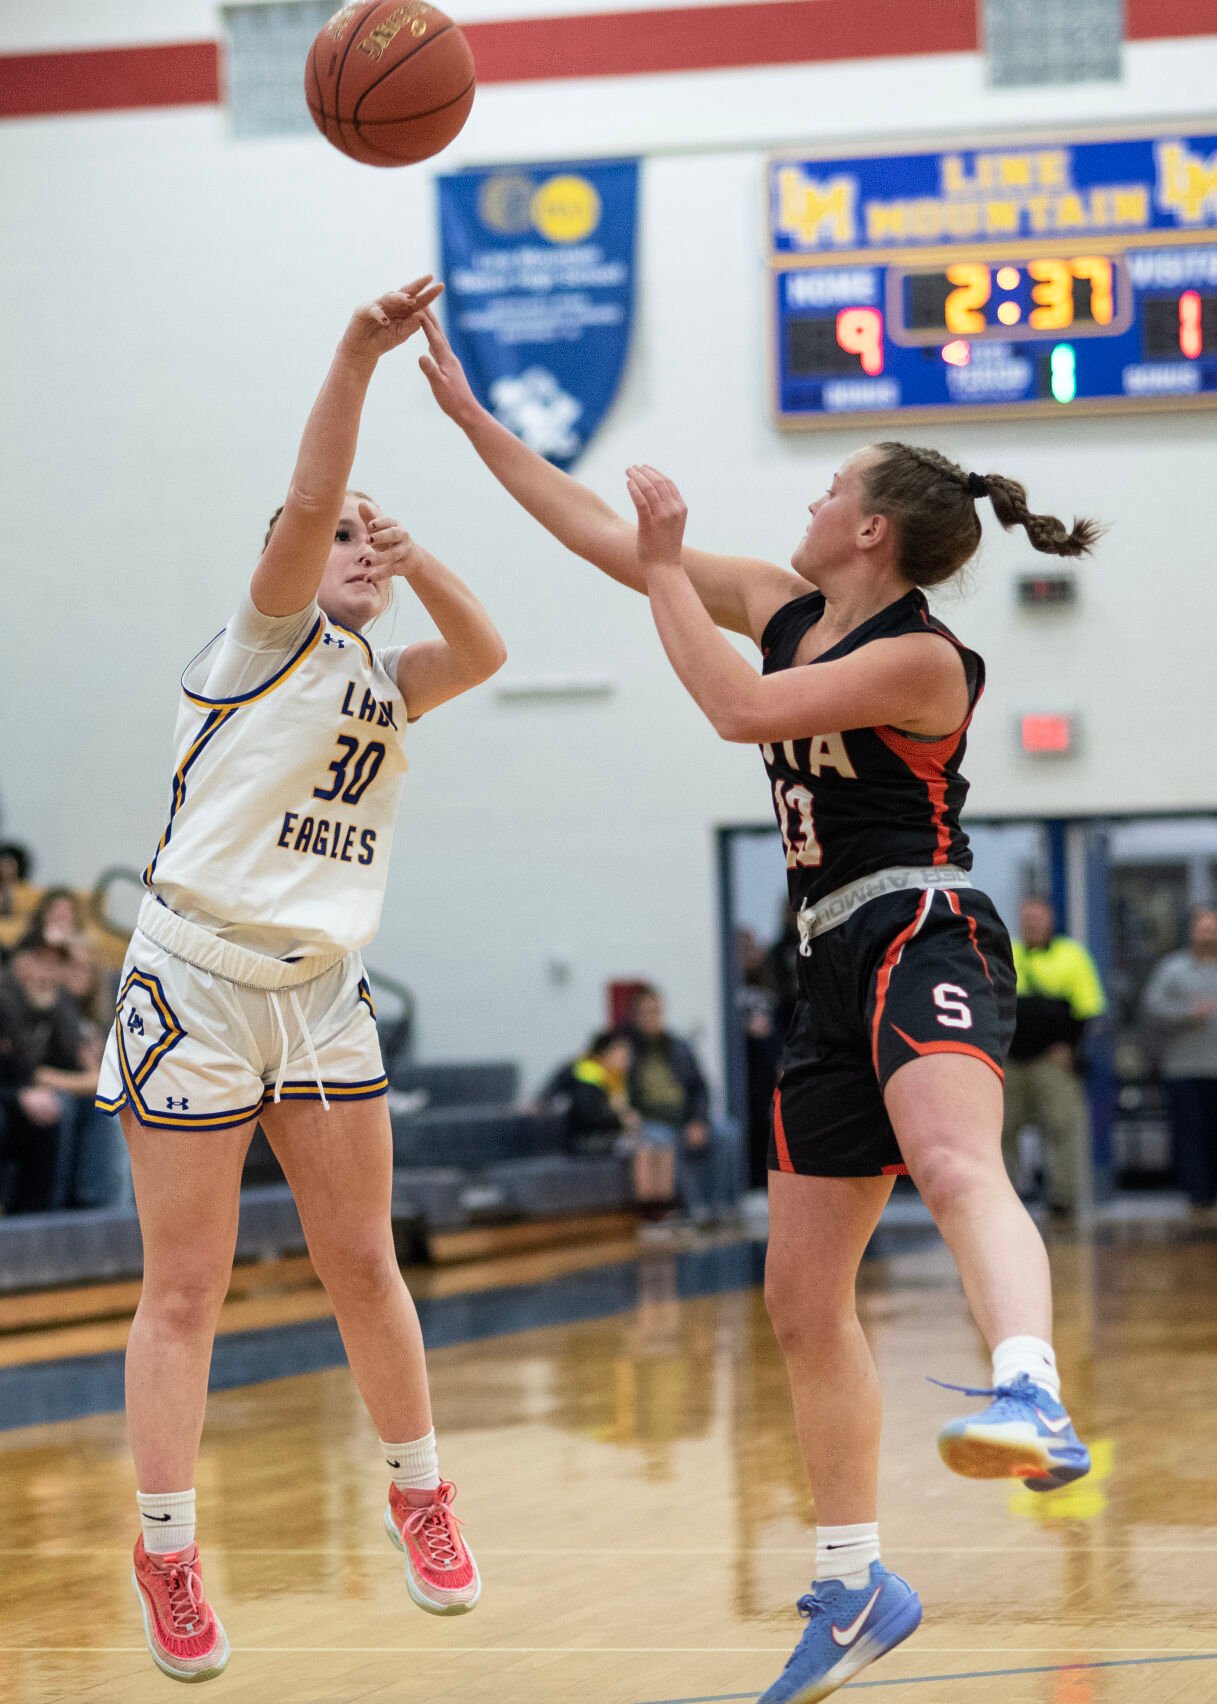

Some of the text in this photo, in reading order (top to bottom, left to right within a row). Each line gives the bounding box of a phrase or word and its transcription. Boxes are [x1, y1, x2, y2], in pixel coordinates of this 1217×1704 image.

[942, 149, 1067, 192] LINE
[867, 186, 1149, 241] MOUNTAIN
[944, 256, 1114, 335] 2:37
[836, 306, 884, 376] 9
[1051, 343, 1077, 403] 1
[312, 733, 386, 806] 30
[277, 811, 377, 866] EAGLES
[774, 779, 823, 869] 13
[932, 982, 973, 1030] S
